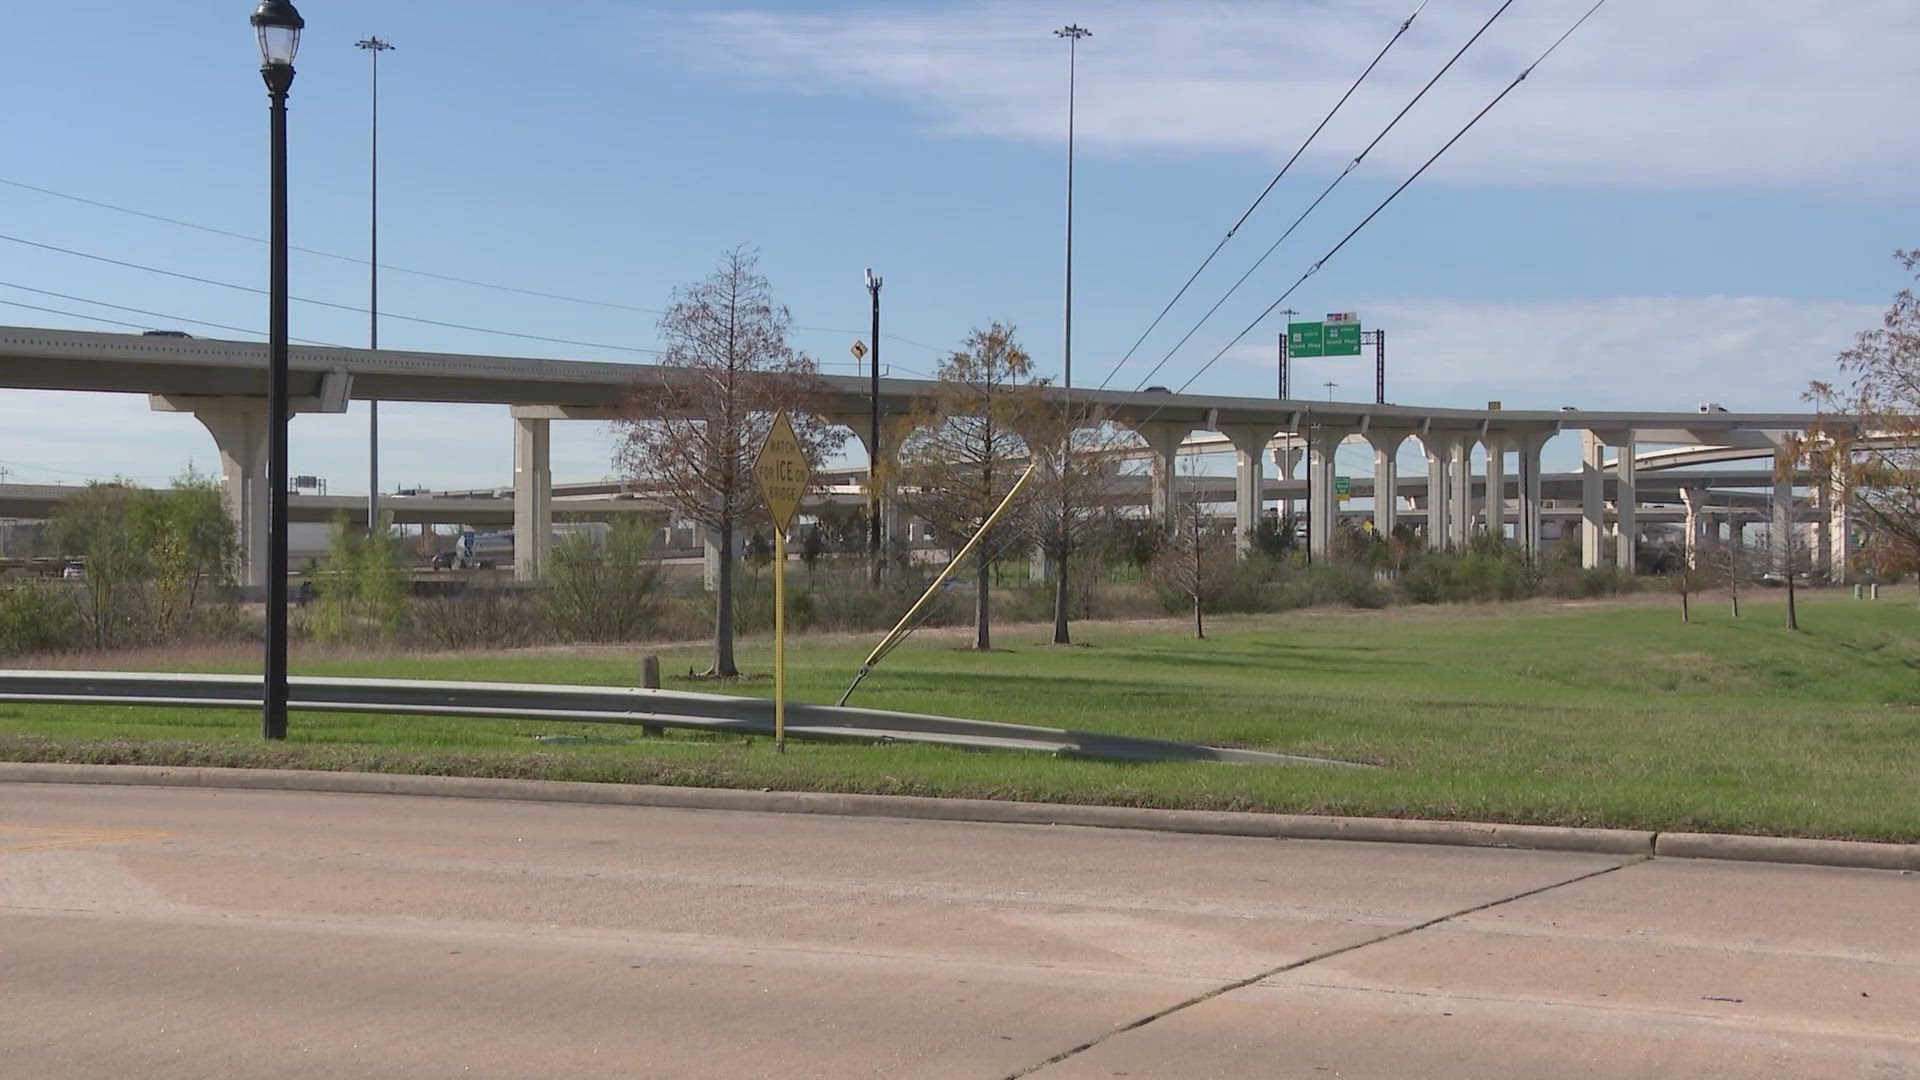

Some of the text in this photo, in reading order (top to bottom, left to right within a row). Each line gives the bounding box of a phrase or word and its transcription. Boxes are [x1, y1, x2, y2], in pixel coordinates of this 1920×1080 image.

[770, 440, 795, 454] WATCH
[759, 460, 806, 483] FOR ICE ON
[769, 486, 797, 501] BRIDGE
